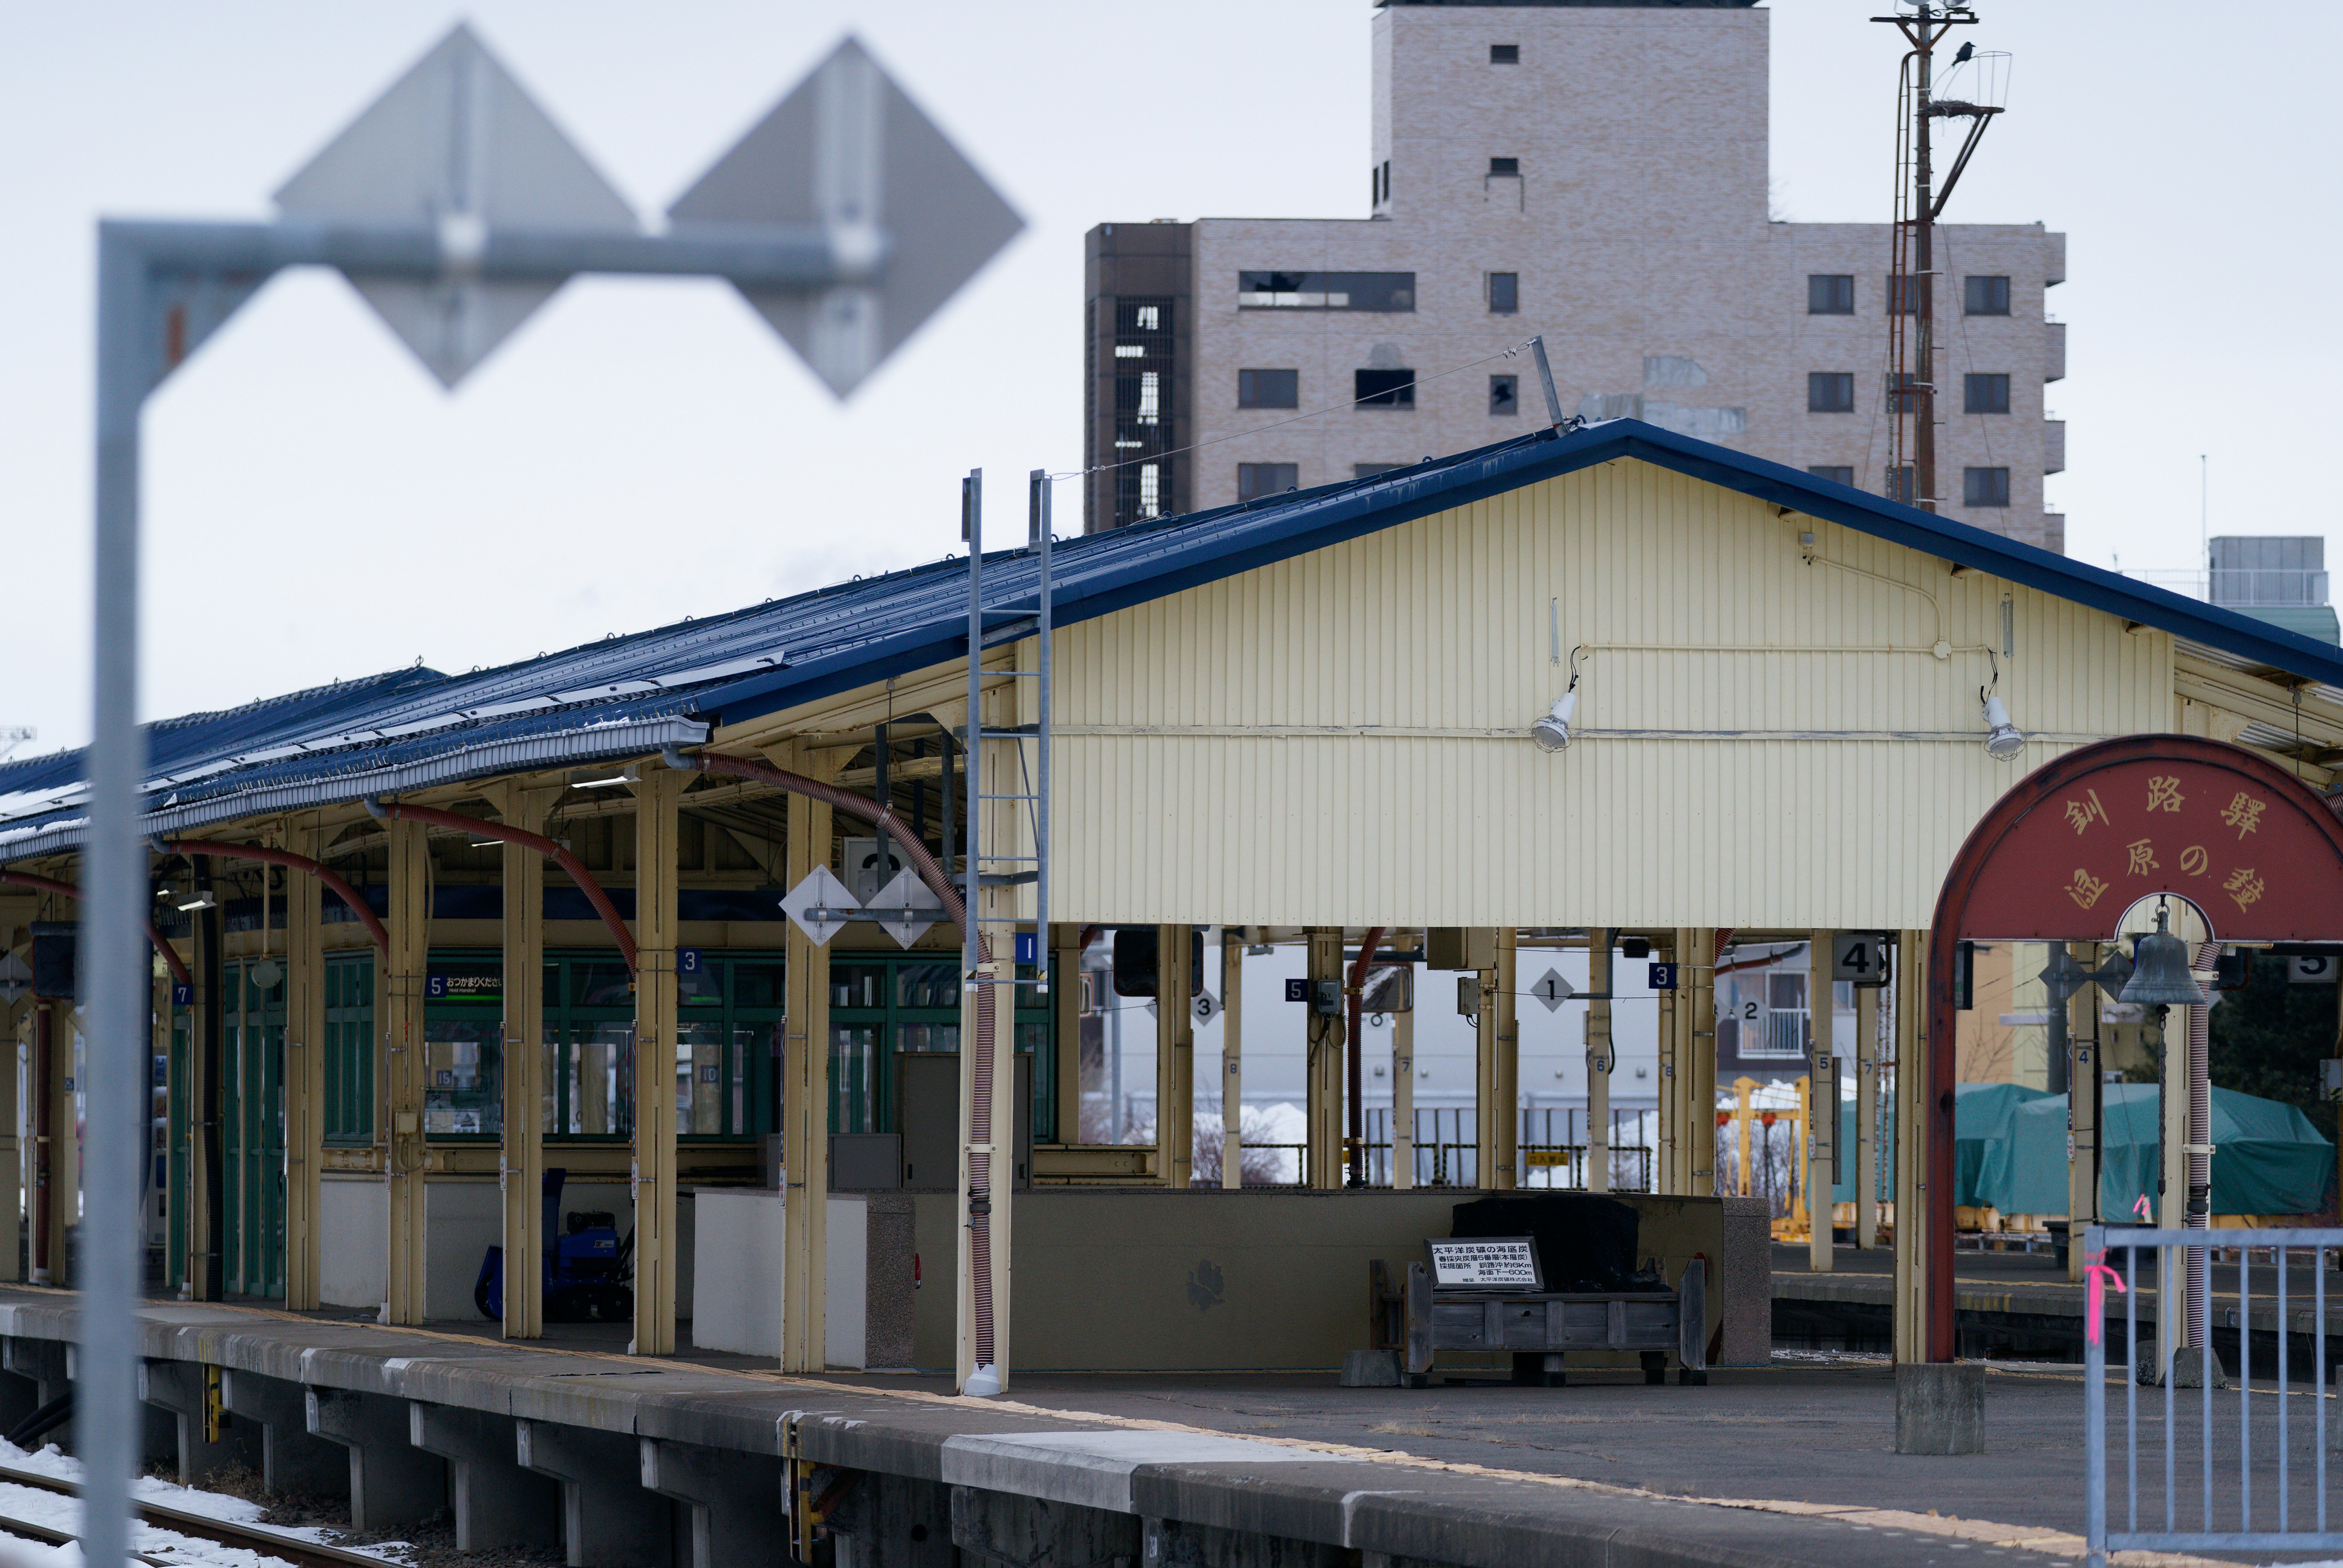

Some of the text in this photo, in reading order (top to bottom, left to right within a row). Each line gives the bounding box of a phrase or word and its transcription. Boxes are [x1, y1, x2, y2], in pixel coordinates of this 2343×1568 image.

[685, 952, 695, 971] 3
[1841, 942, 1870, 973] 4
[1656, 966, 1667, 985] 3
[432, 977, 441, 995] 5
[1291, 982, 1301, 999] 5
[1547, 979, 1555, 1000] 1
[178, 987, 187, 1002] 7
[1197, 998, 1211, 1015] 3
[1745, 1002, 1757, 1019] 2
[1820, 1057, 1828, 1069] 5
[2079, 1051, 2088, 1064] 4
[1230, 1063, 1237, 1074] 8
[1402, 1061, 1410, 1072] 7
[1597, 1060, 1605, 1072] 6
[1865, 1064, 1872, 1074] 7
[439, 1072, 450, 1084] 15
